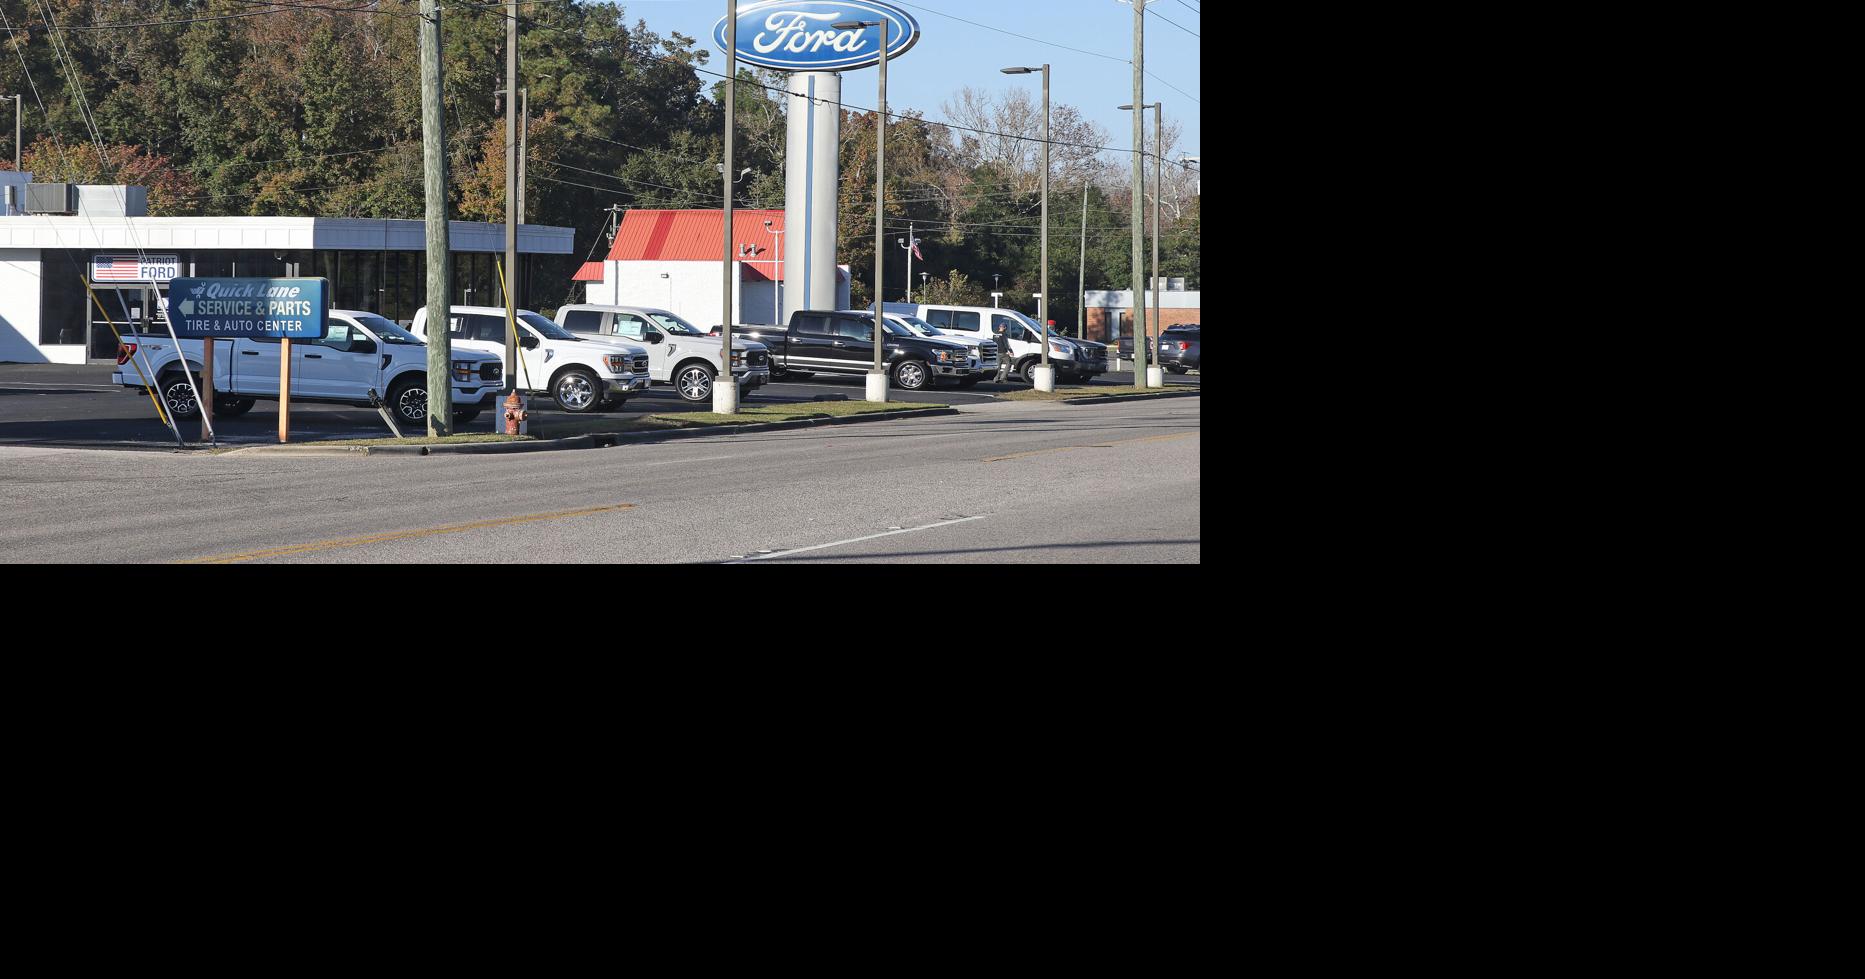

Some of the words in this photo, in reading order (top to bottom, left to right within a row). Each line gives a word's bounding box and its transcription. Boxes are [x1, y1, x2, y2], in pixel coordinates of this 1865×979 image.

[753, 11, 866, 54] Ford
[141, 257, 176, 265] PATRIOT
[141, 267, 175, 279] FORD
[206, 282, 252, 299] Quick
[257, 283, 301, 298] Lane
[198, 300, 252, 315] SERVICE
[255, 301, 265, 315] &
[269, 301, 311, 316] PARTS
[186, 320, 210, 331] TIRE
[214, 320, 220, 331] &
[224, 320, 253, 331] AUTO
[256, 321, 302, 332] CENTER
